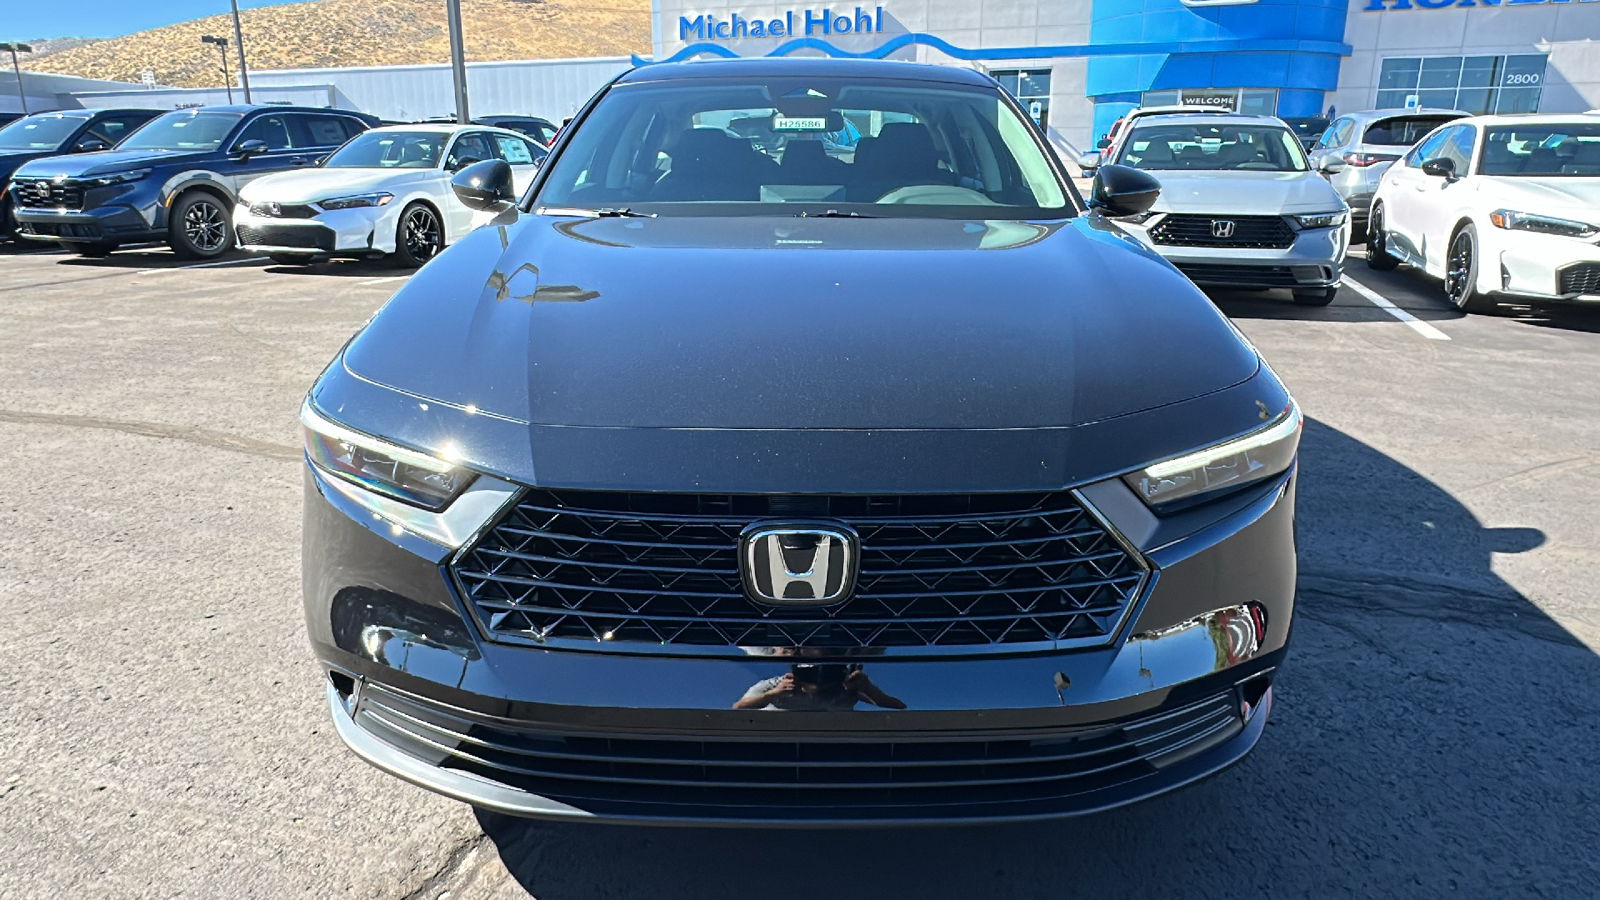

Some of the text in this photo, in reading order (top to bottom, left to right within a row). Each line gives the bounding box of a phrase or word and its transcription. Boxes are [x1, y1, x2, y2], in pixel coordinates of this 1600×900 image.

[679, 6, 883, 41] Michael Hohl
[1506, 73, 1539, 84] 2800
